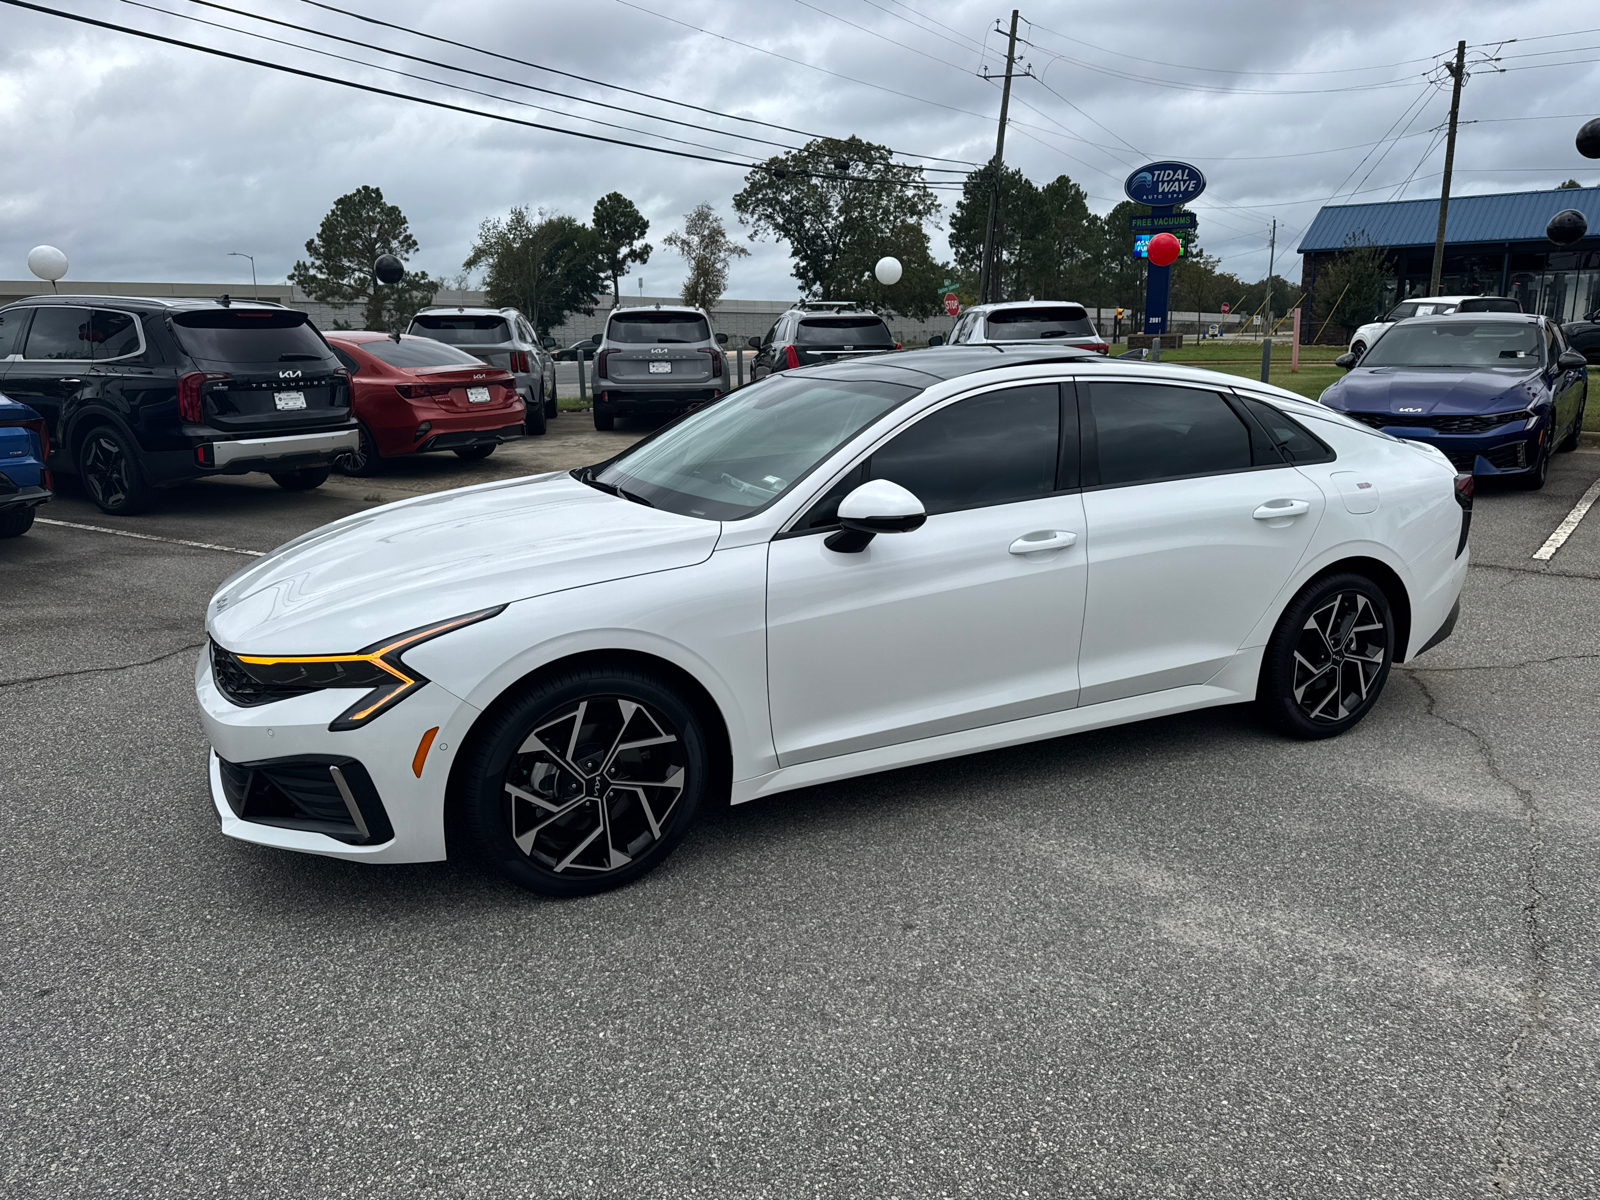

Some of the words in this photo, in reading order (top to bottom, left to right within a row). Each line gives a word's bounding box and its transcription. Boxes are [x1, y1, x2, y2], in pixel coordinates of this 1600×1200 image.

[1153, 169, 1189, 181] TIDAL
[1158, 181, 1196, 192] WAVE
[1154, 216, 1191, 225] VACUUMS
[945, 300, 958, 309] STOP
